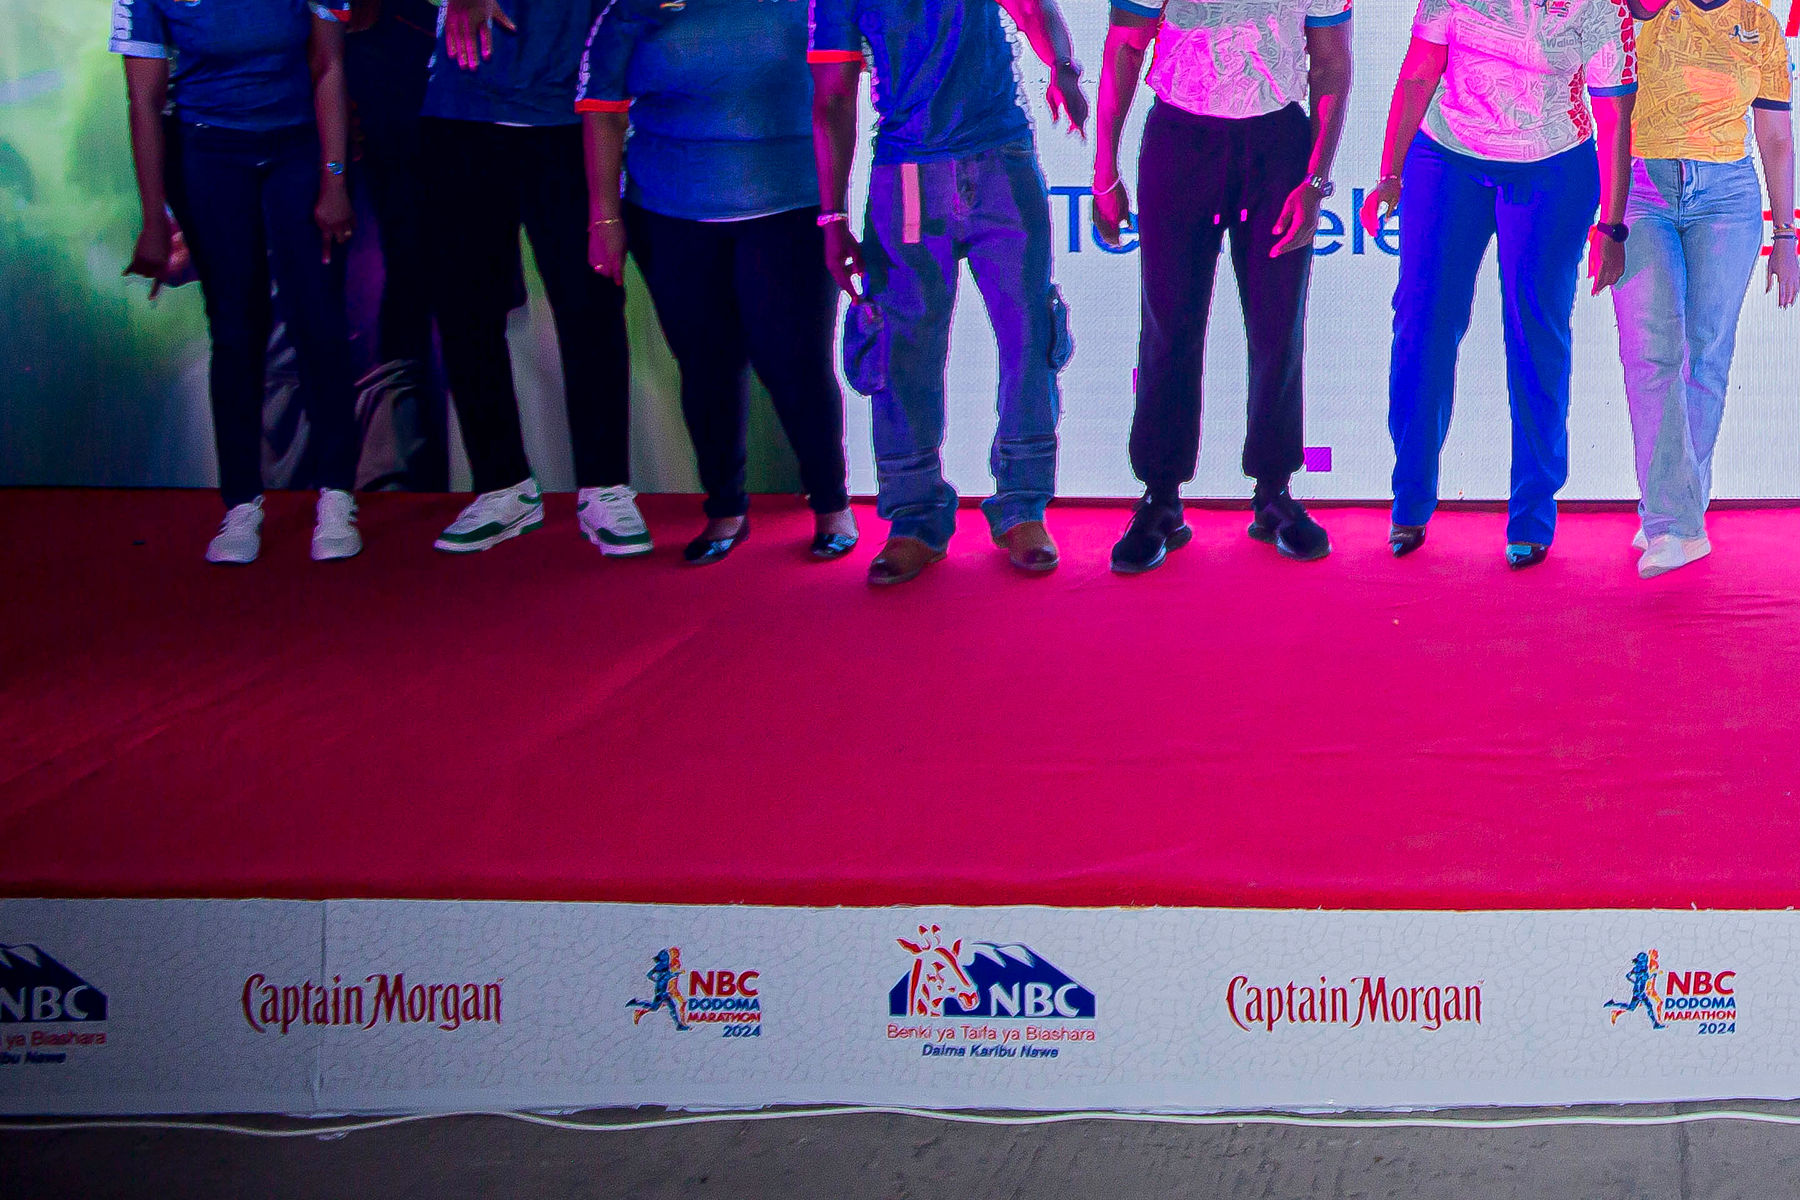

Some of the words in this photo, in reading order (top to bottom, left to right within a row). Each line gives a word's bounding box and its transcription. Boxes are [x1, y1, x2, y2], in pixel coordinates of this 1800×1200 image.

[688, 970, 760, 997] NBC
[1666, 971, 1737, 996] NBC
[0, 984, 89, 1021] NBC
[241, 972, 363, 1034] Captain
[361, 972, 504, 1032] Morgan
[687, 998, 761, 1011] DODOMA
[988, 982, 1079, 1018] NBC
[1226, 975, 1349, 1032] Captain
[1349, 976, 1484, 1031] Morgan
[1664, 997, 1736, 1009] DODOMA
[1664, 1010, 1736, 1021] MARATHON
[722, 1025, 761, 1038] 2024
[887, 1025, 931, 1039] Benki
[937, 1027, 955, 1042] ya
[960, 1024, 997, 1040] Taifa
[1002, 1028, 1020, 1043] ya
[1026, 1025, 1096, 1041] Biashara
[1698, 1023, 1736, 1035] 2024
[922, 1044, 965, 1057] Daima
[969, 1043, 1016, 1057] Karibu
[1019, 1045, 1059, 1058] Nawe
